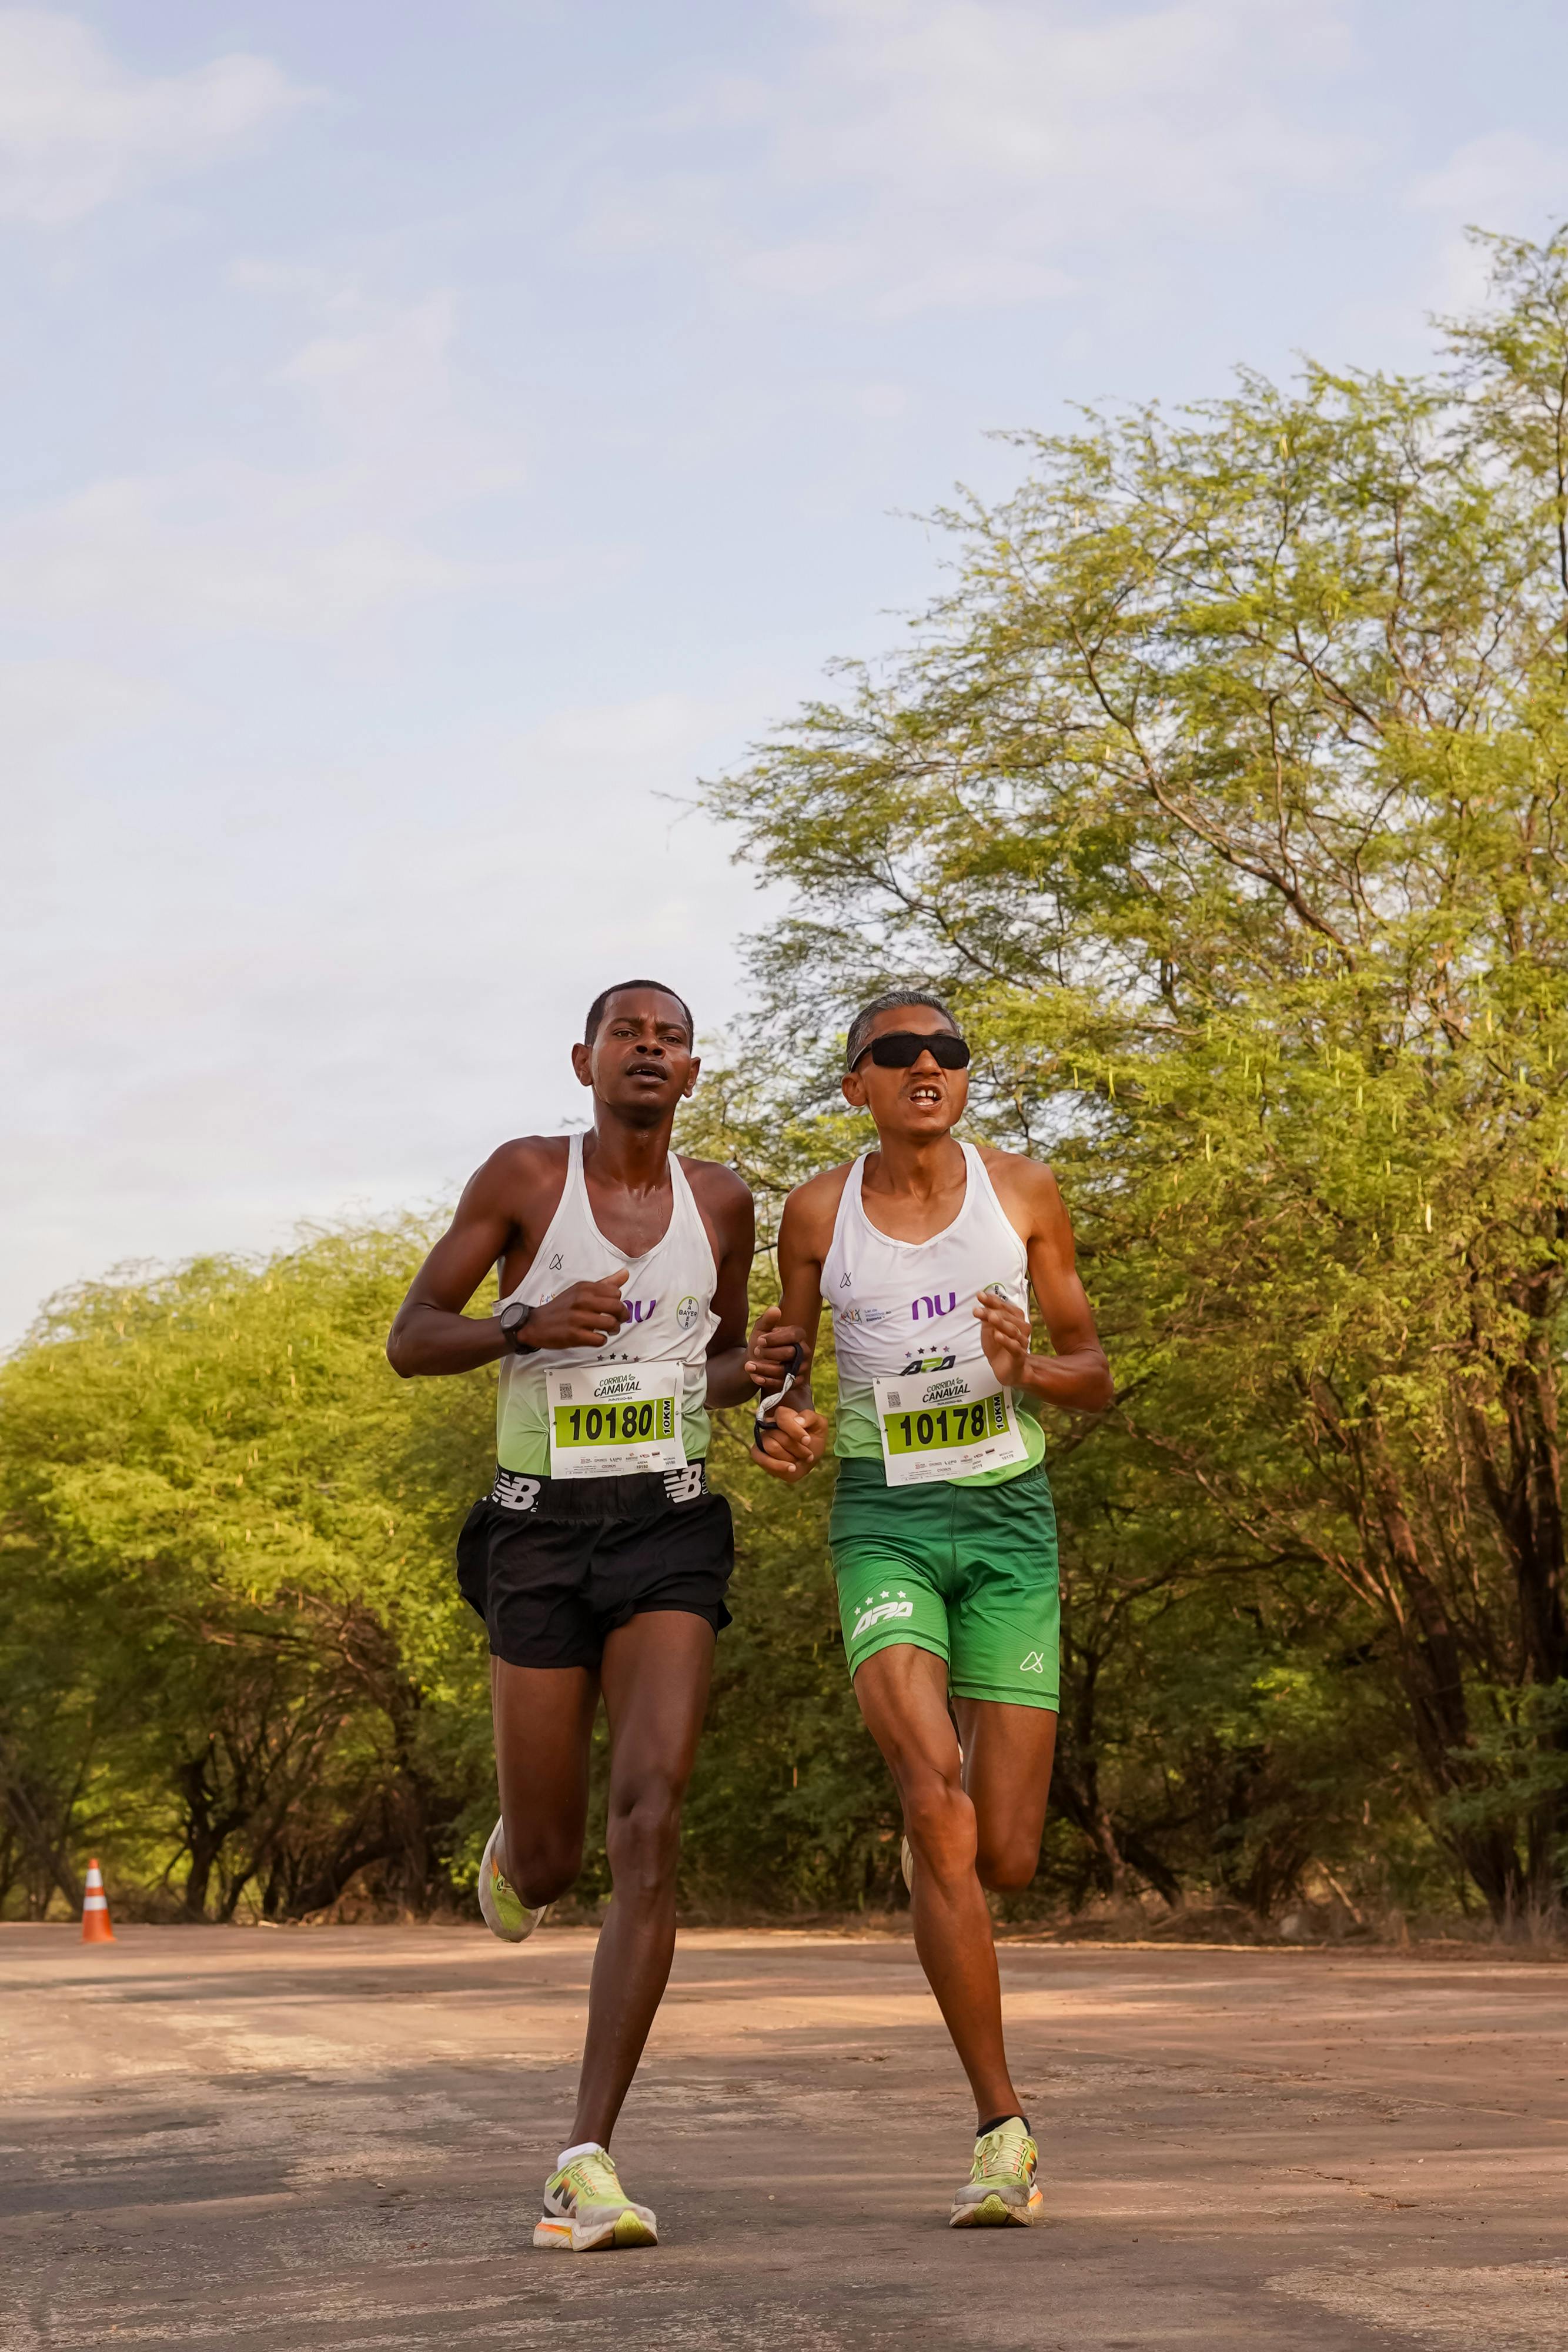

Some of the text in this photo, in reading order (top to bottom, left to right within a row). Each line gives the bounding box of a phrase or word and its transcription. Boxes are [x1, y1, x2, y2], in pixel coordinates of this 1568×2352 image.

[594, 1381, 641, 1397] CANAVIAL
[600, 1375, 627, 1387] CORRIDA
[922, 1384, 971, 1403] CANAVIAL
[927, 1379, 955, 1393] CORRIDA
[570, 1404, 653, 1441] 10180
[900, 1404, 984, 1446] 10178
[994, 1396, 1004, 1429] 10KM
[851, 1601, 914, 1641] APA
